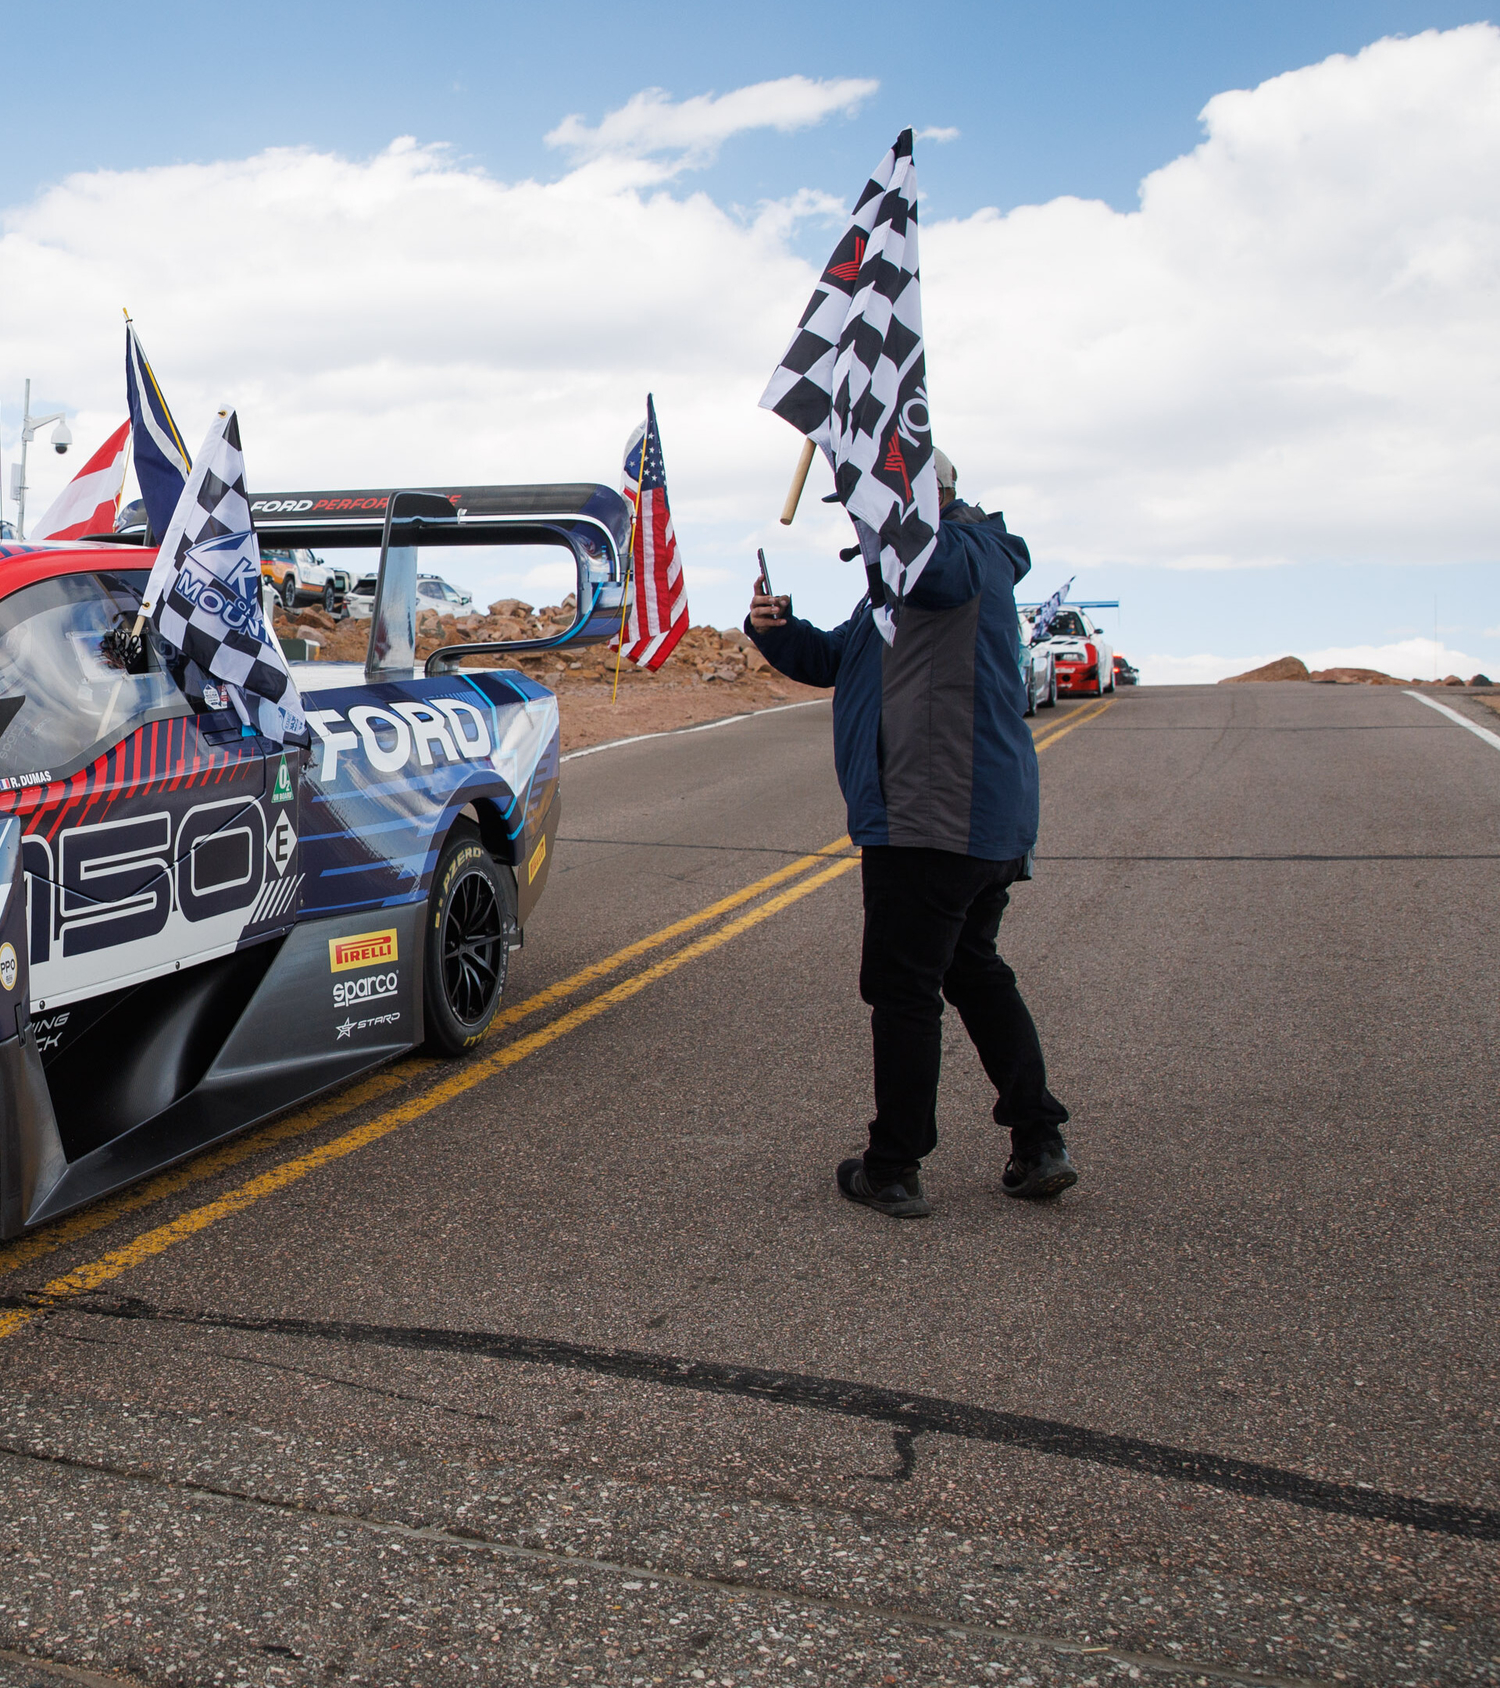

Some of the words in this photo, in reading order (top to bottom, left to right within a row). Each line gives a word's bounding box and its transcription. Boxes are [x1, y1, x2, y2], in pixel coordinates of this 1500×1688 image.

[251, 499, 313, 512] FORD
[304, 698, 491, 782] FORD
[9, 777, 20, 788] R.
[20, 770, 52, 786] DUMAS
[276, 824, 289, 862] E
[335, 935, 392, 965] PIRELLI
[0, 958, 16, 975] PPO
[332, 972, 398, 1008] sparco
[357, 1012, 401, 1030] STARD
